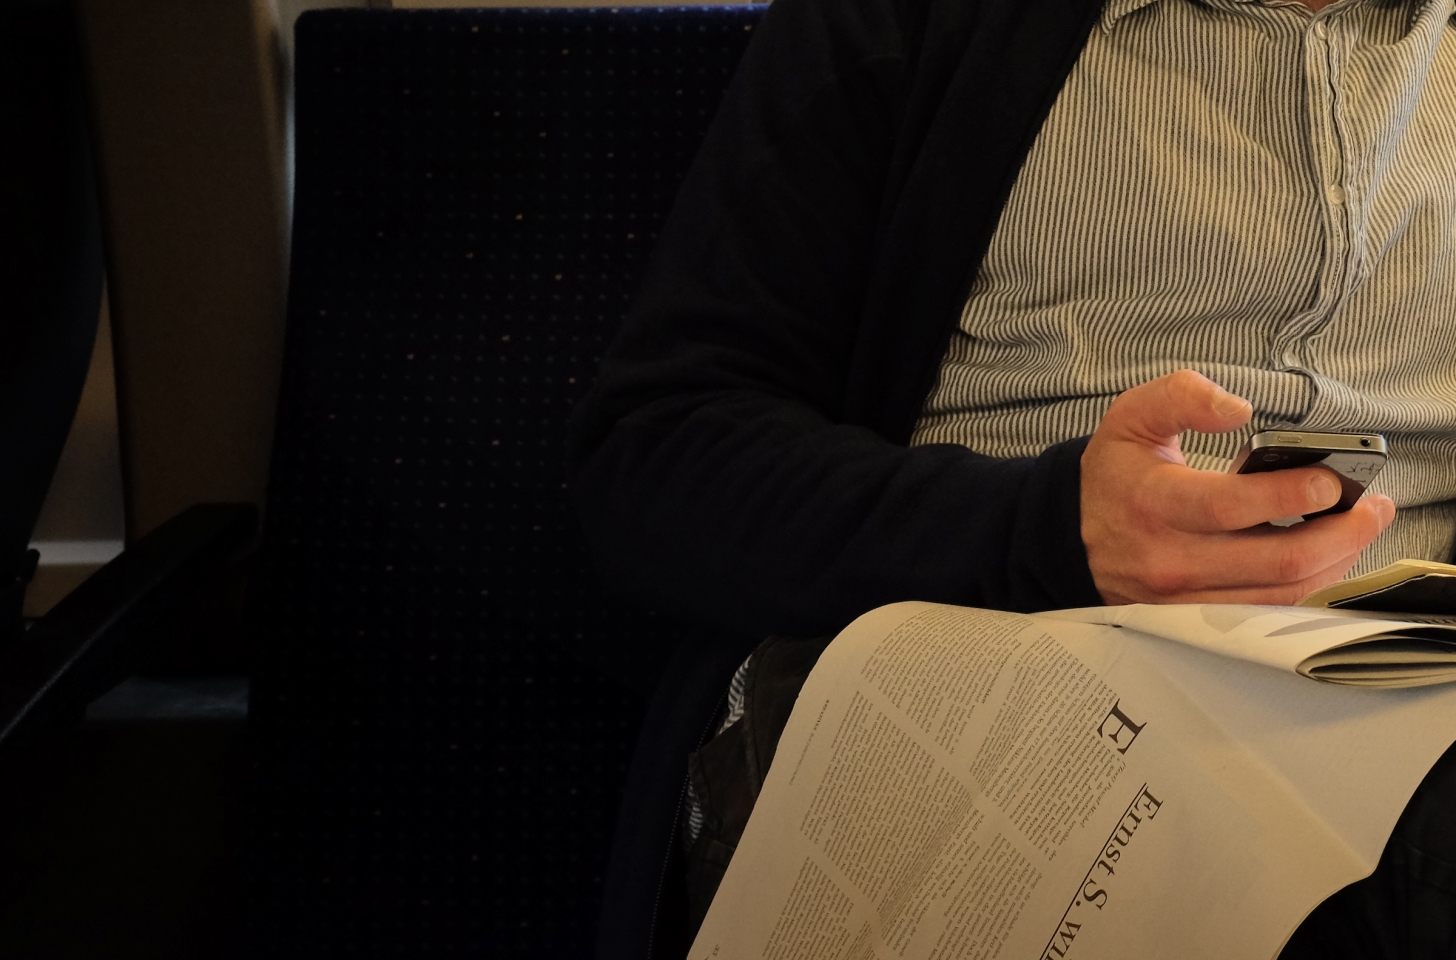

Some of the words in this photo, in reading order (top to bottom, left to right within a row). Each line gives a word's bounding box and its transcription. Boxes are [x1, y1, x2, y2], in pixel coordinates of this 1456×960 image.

[1097, 698, 1147, 755] E
[1097, 785, 1164, 876] Ernst
[1075, 878, 1108, 910] S.
[1044, 920, 1082, 960] wi
